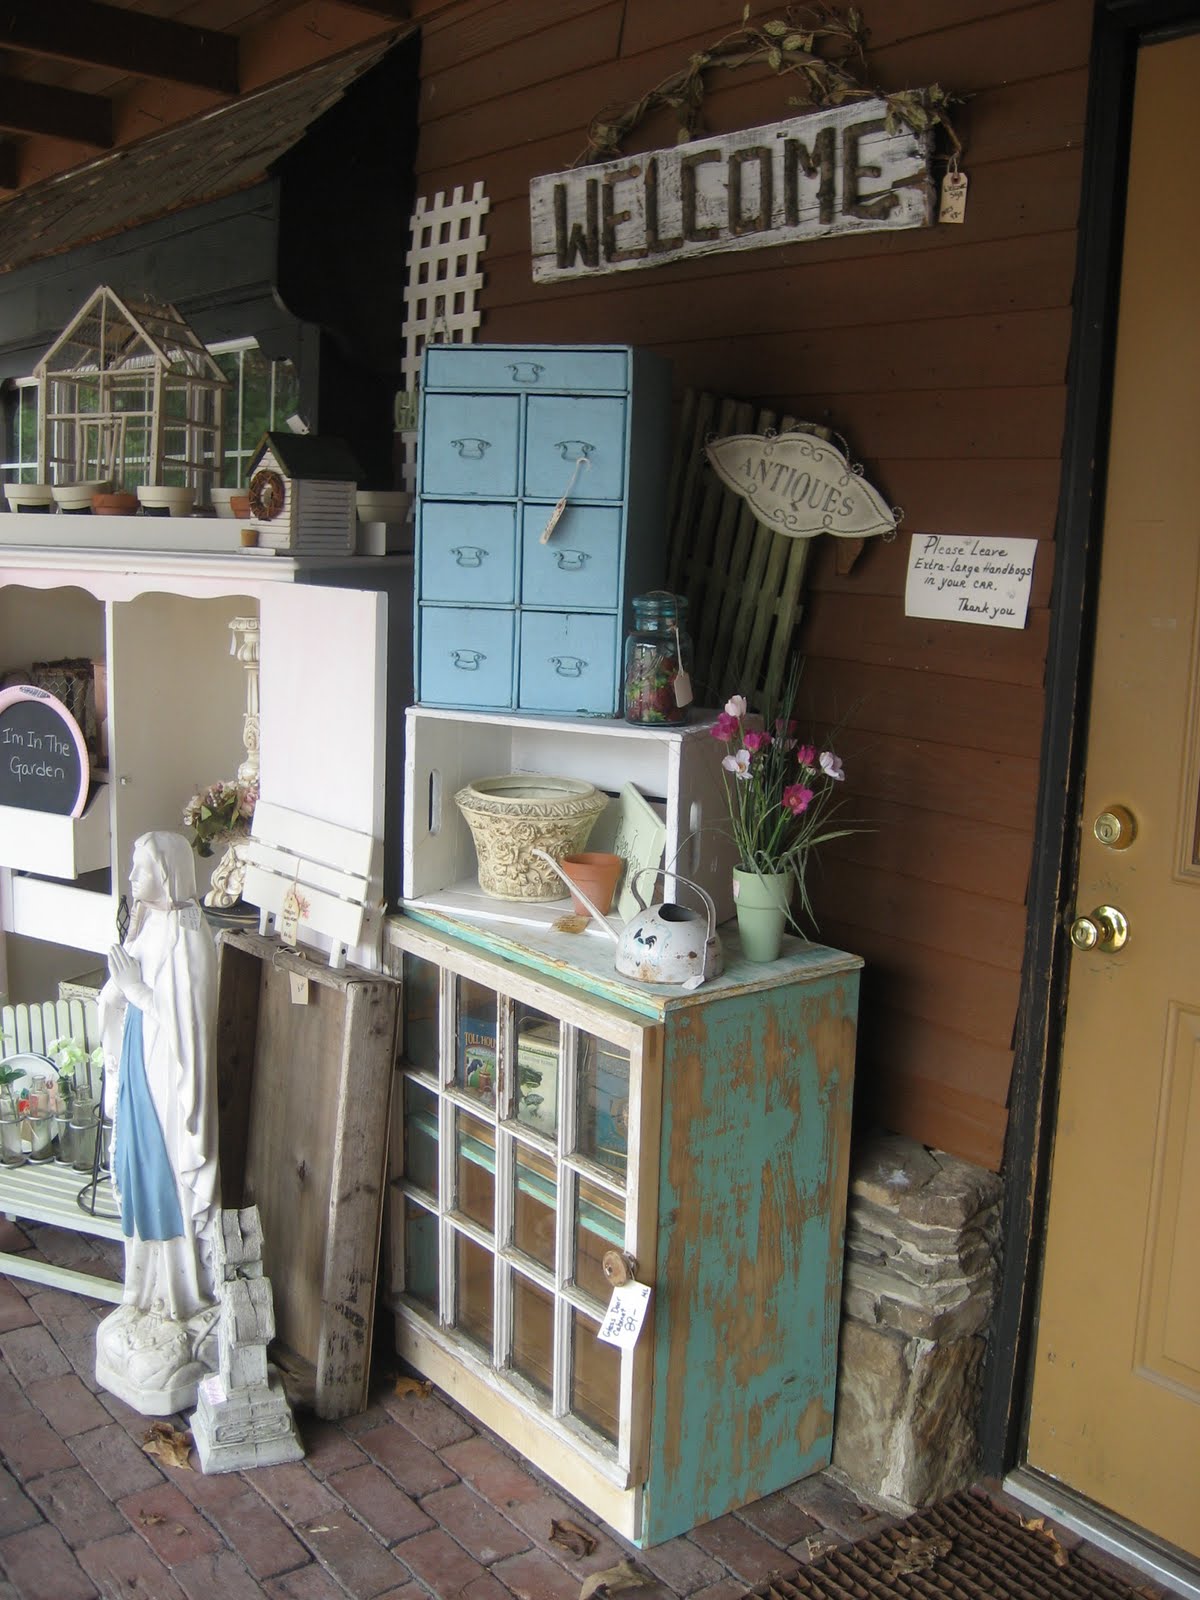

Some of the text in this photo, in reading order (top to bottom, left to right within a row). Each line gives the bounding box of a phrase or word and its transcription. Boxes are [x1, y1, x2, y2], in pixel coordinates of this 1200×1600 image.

[553, 117, 900, 270] WELCOME
[738, 457, 855, 517] ANTIQUES
[924, 535, 1009, 557] Please Leave
[924, 571, 935, 585] in
[958, 597, 1016, 619] Thank you
[2, 727, 71, 757] I'm In The
[9, 755, 65, 782] Garden
[464, 1031, 496, 1049] TOLL HOU
